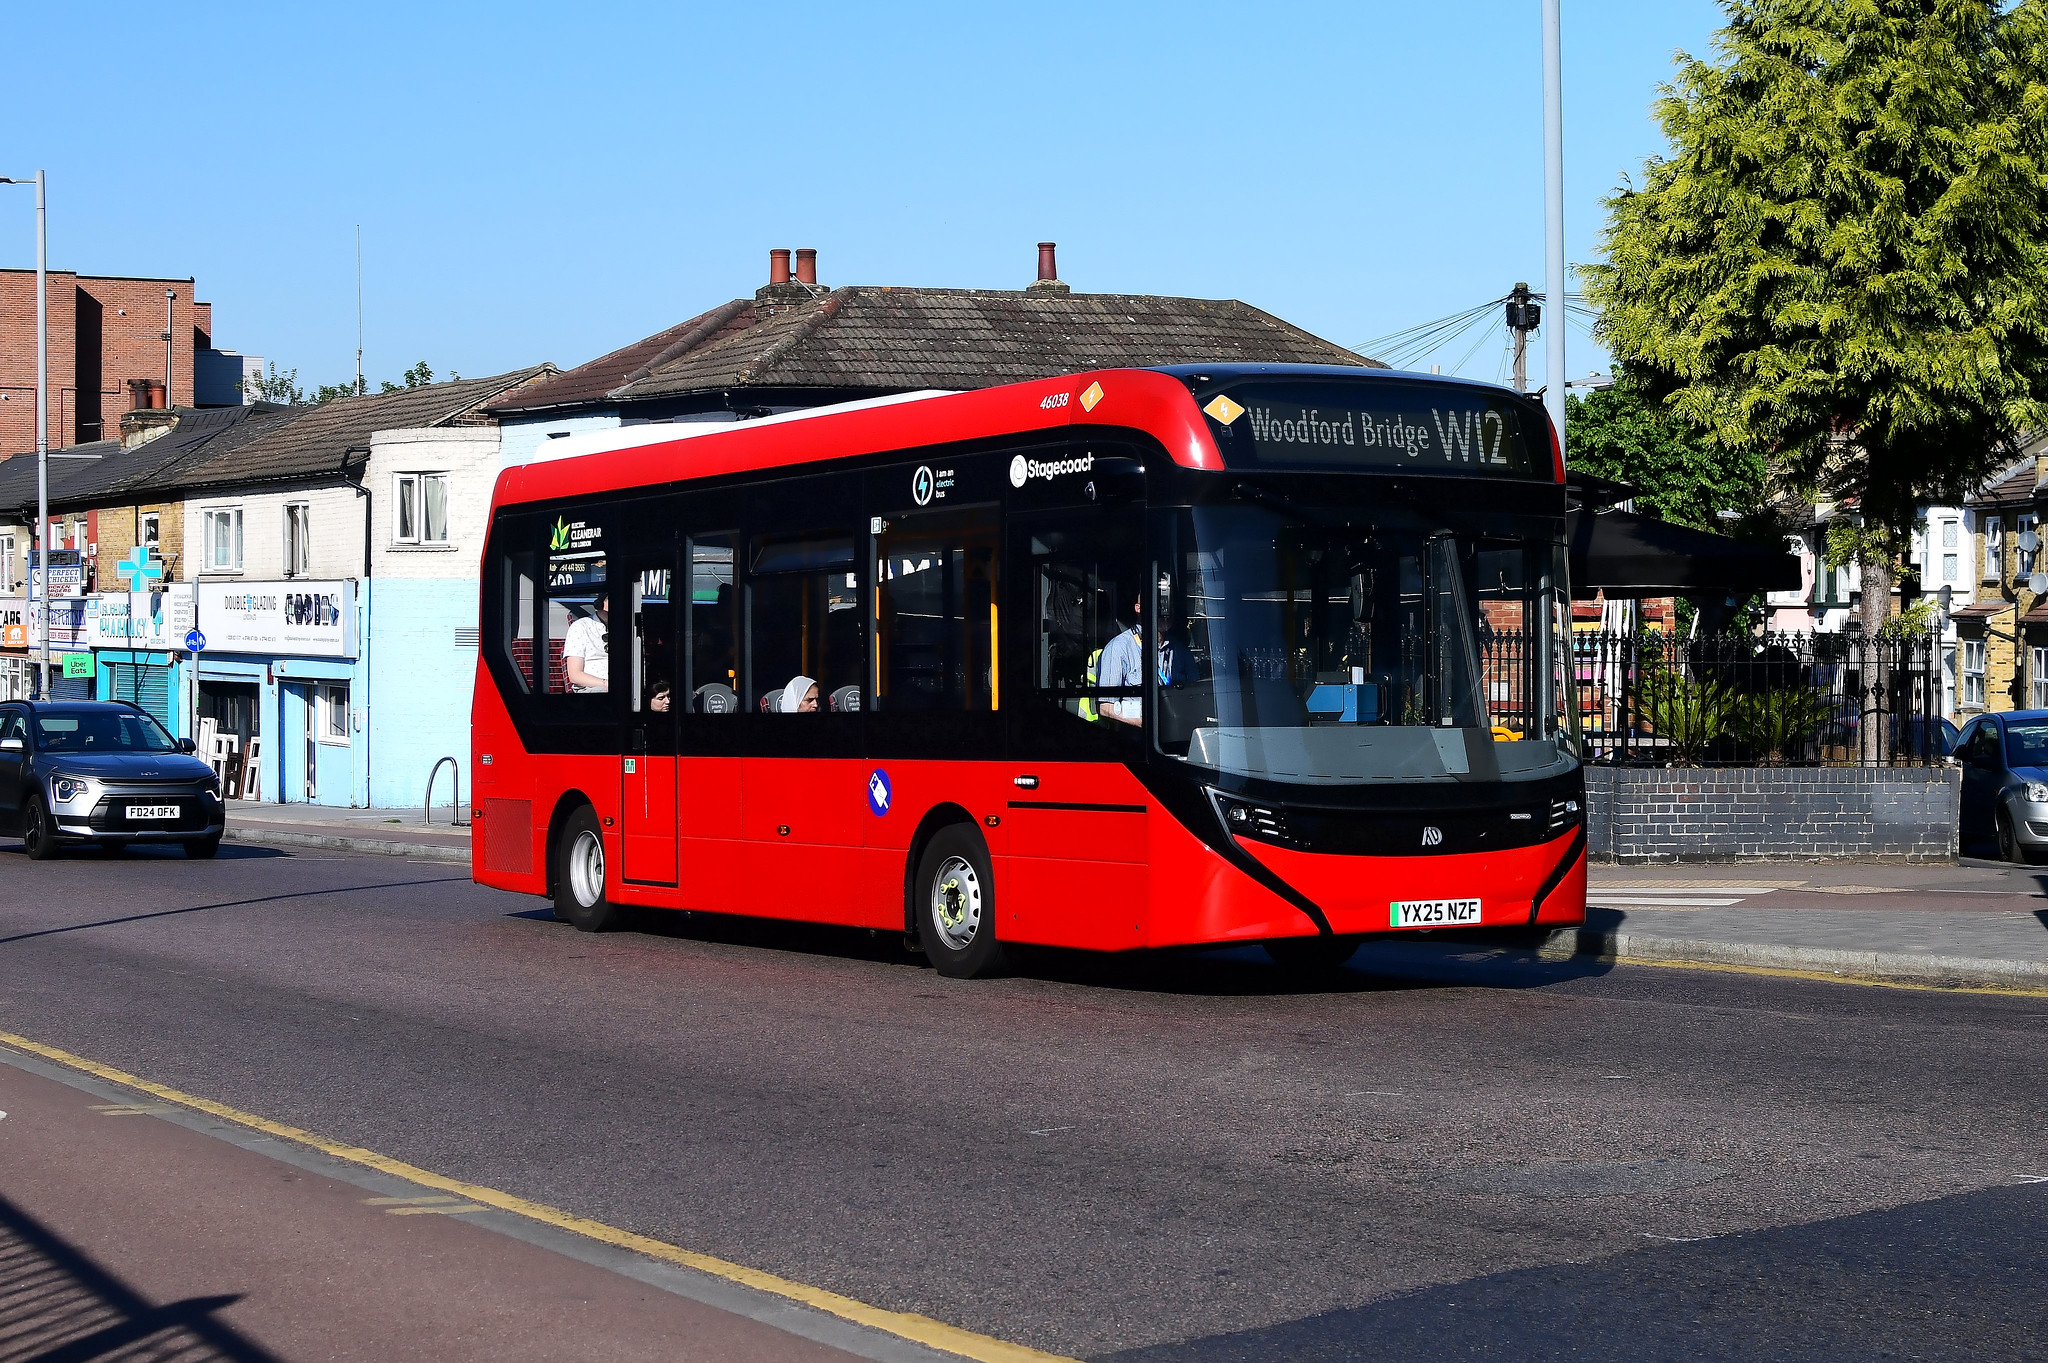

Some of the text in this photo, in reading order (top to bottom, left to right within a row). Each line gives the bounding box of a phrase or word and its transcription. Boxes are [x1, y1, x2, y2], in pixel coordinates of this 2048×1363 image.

[1039, 392, 1070, 410] 46038
[1247, 407, 1508, 465] Woodford Bridge W12
[947, 469, 954, 477] an
[1027, 451, 1095, 481] Stagecoach
[936, 479, 955, 488] electric
[936, 489, 946, 499] bus
[48, 569, 79, 577] PERFECT
[225, 596, 277, 610] DOUBLE GLAZING
[100, 618, 147, 636] PHARMACY
[130, 807, 176, 817] FD24 OFK
[1401, 901, 1478, 922] YX25 NZF
